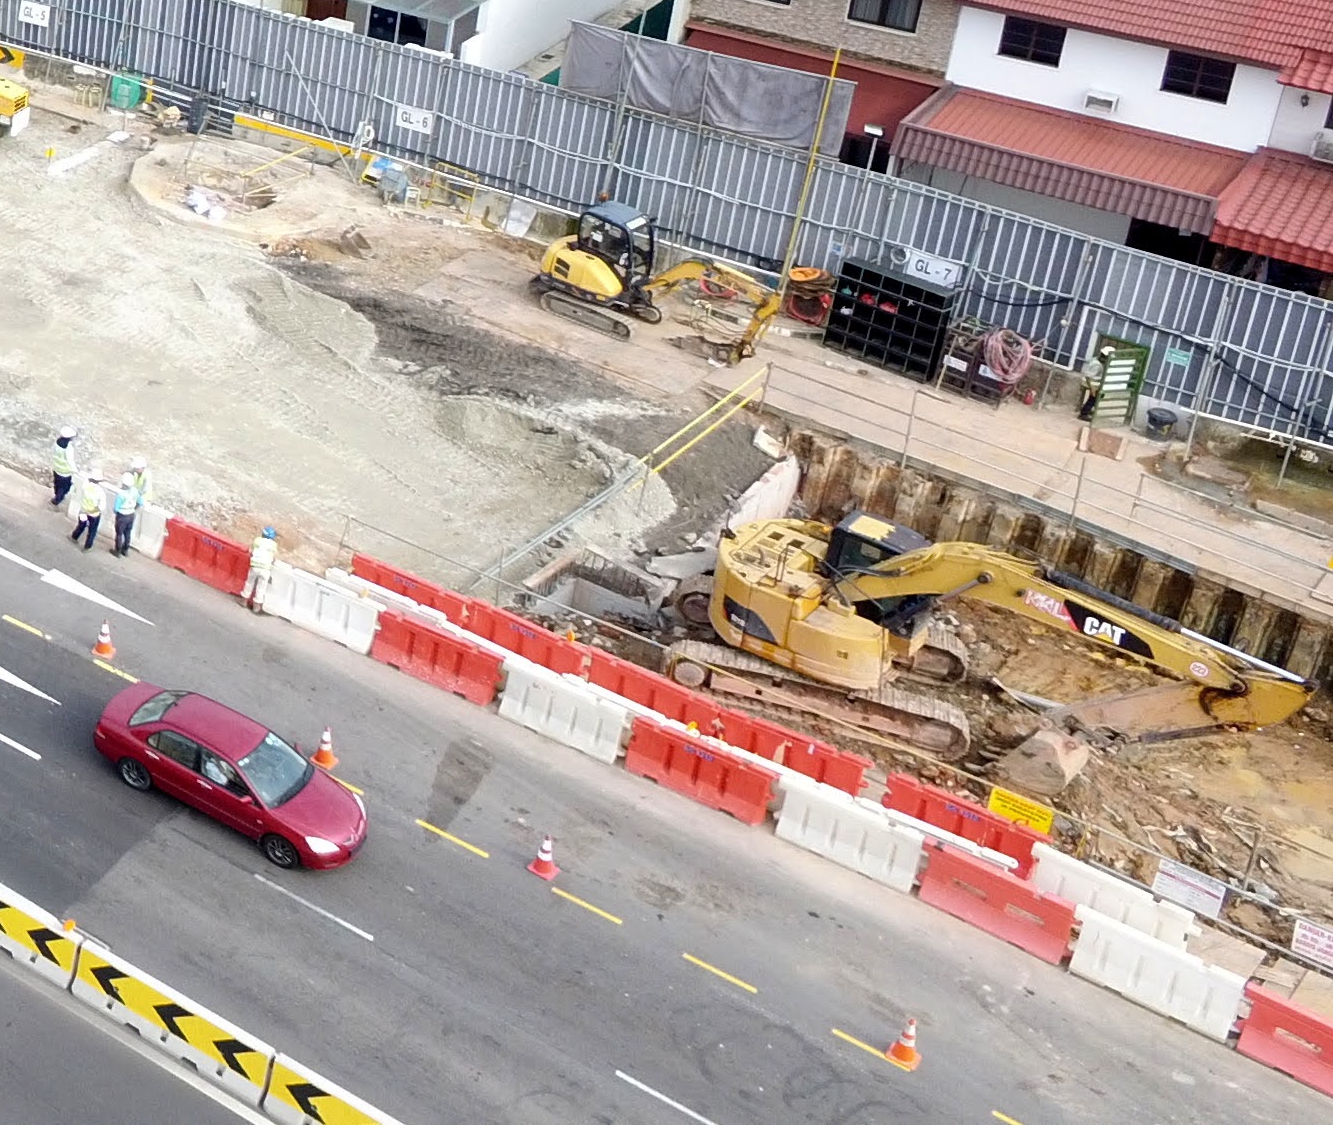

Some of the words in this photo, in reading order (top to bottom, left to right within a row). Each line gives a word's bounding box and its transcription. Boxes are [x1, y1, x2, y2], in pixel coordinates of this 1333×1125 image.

[401, 111, 413, 124] GL
[915, 259, 931, 275] GL
[1083, 617, 1126, 646] CAT
